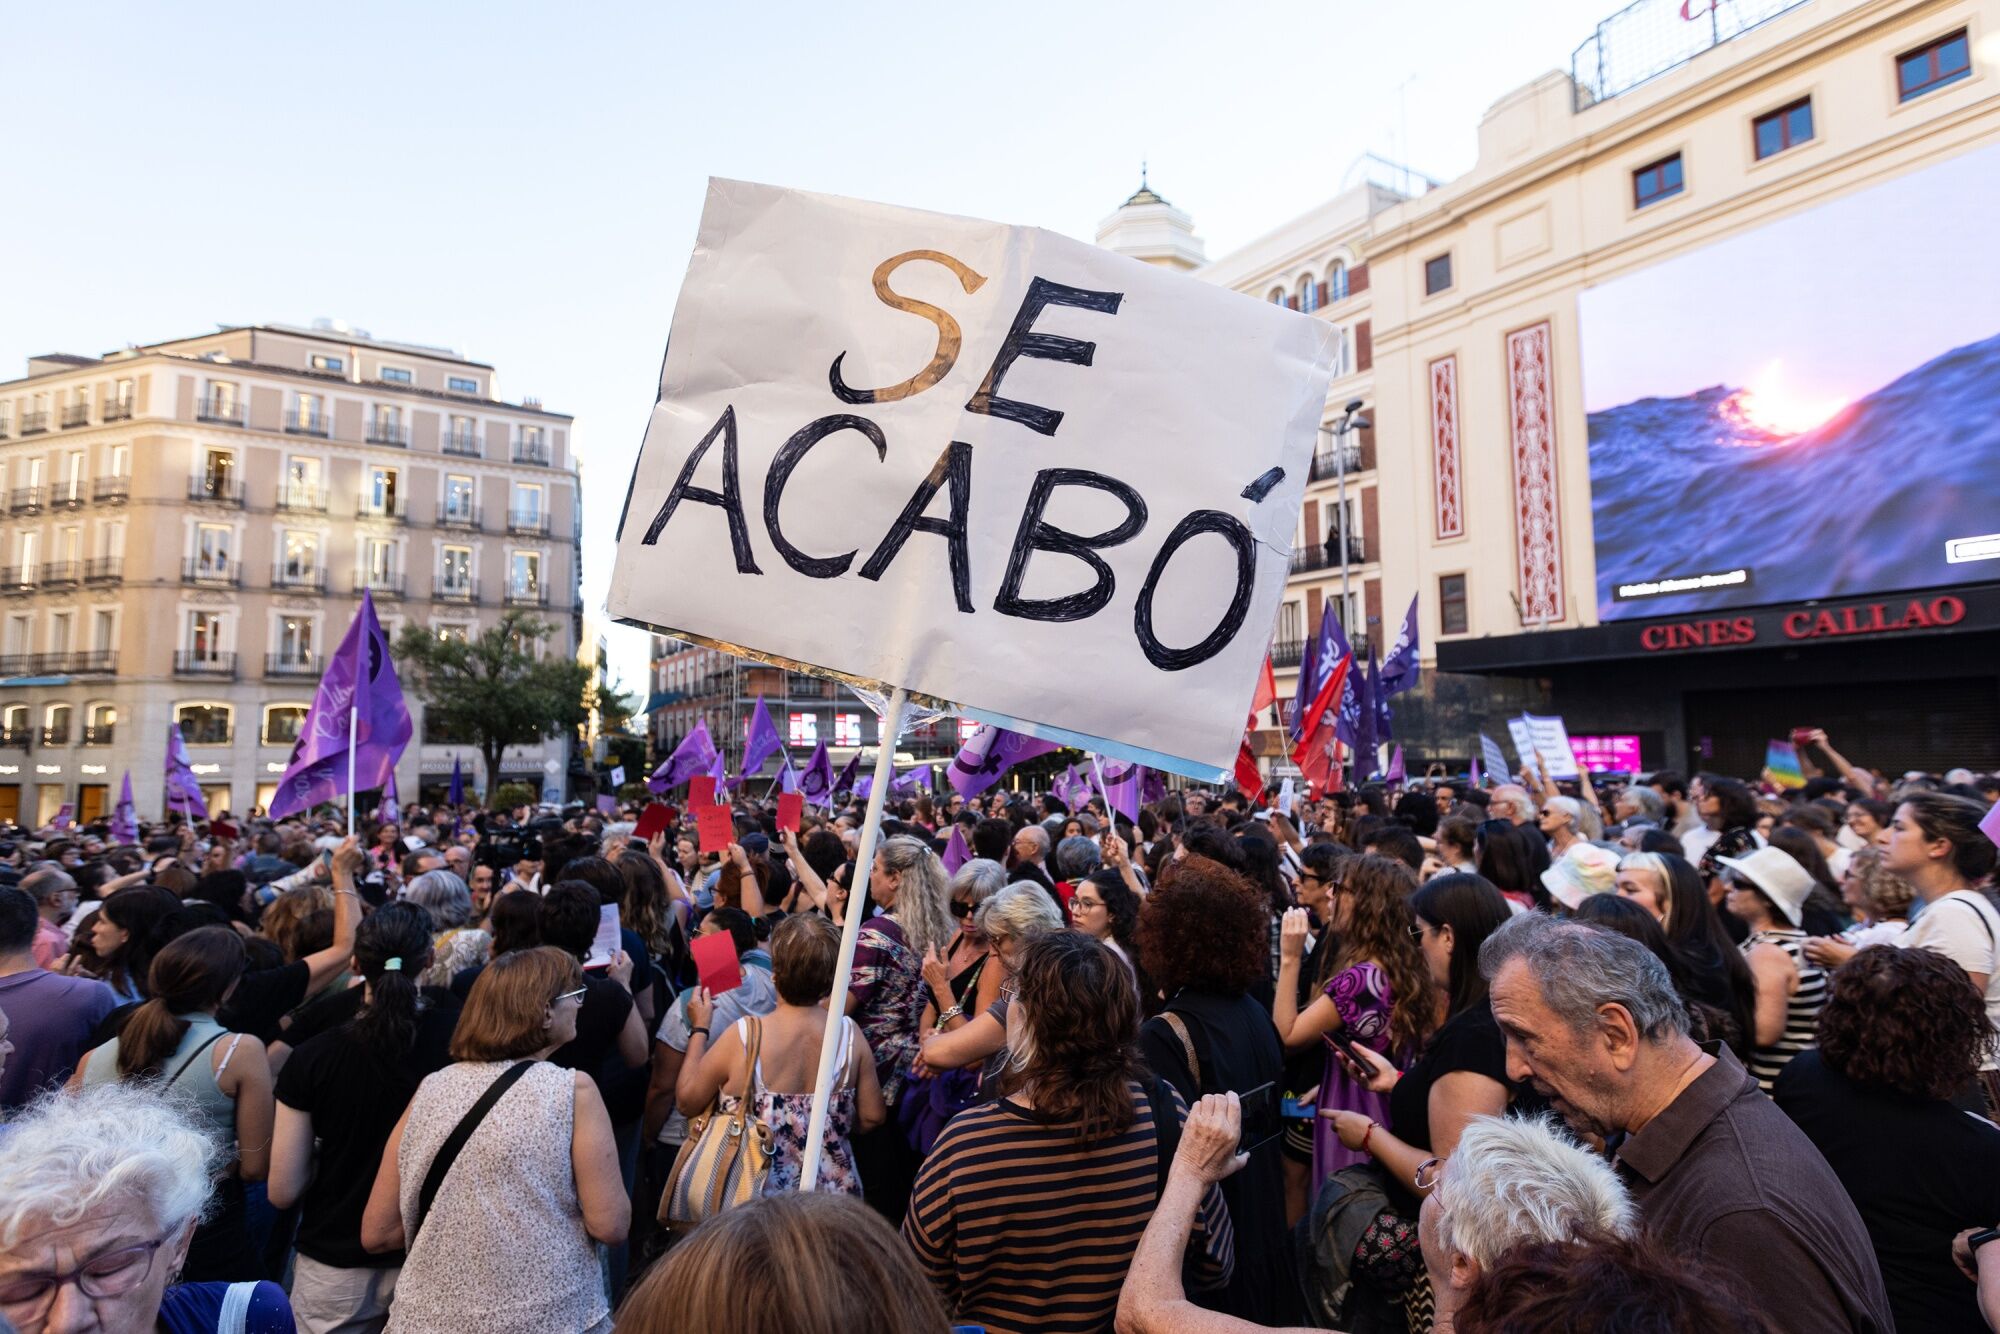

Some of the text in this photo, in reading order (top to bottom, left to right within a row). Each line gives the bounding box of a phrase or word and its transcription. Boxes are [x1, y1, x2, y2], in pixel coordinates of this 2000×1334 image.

[829, 249, 1124, 437] SE
[641, 404, 1287, 672] ACABÓ
[1640, 595, 1966, 650] CINES CALLAO
